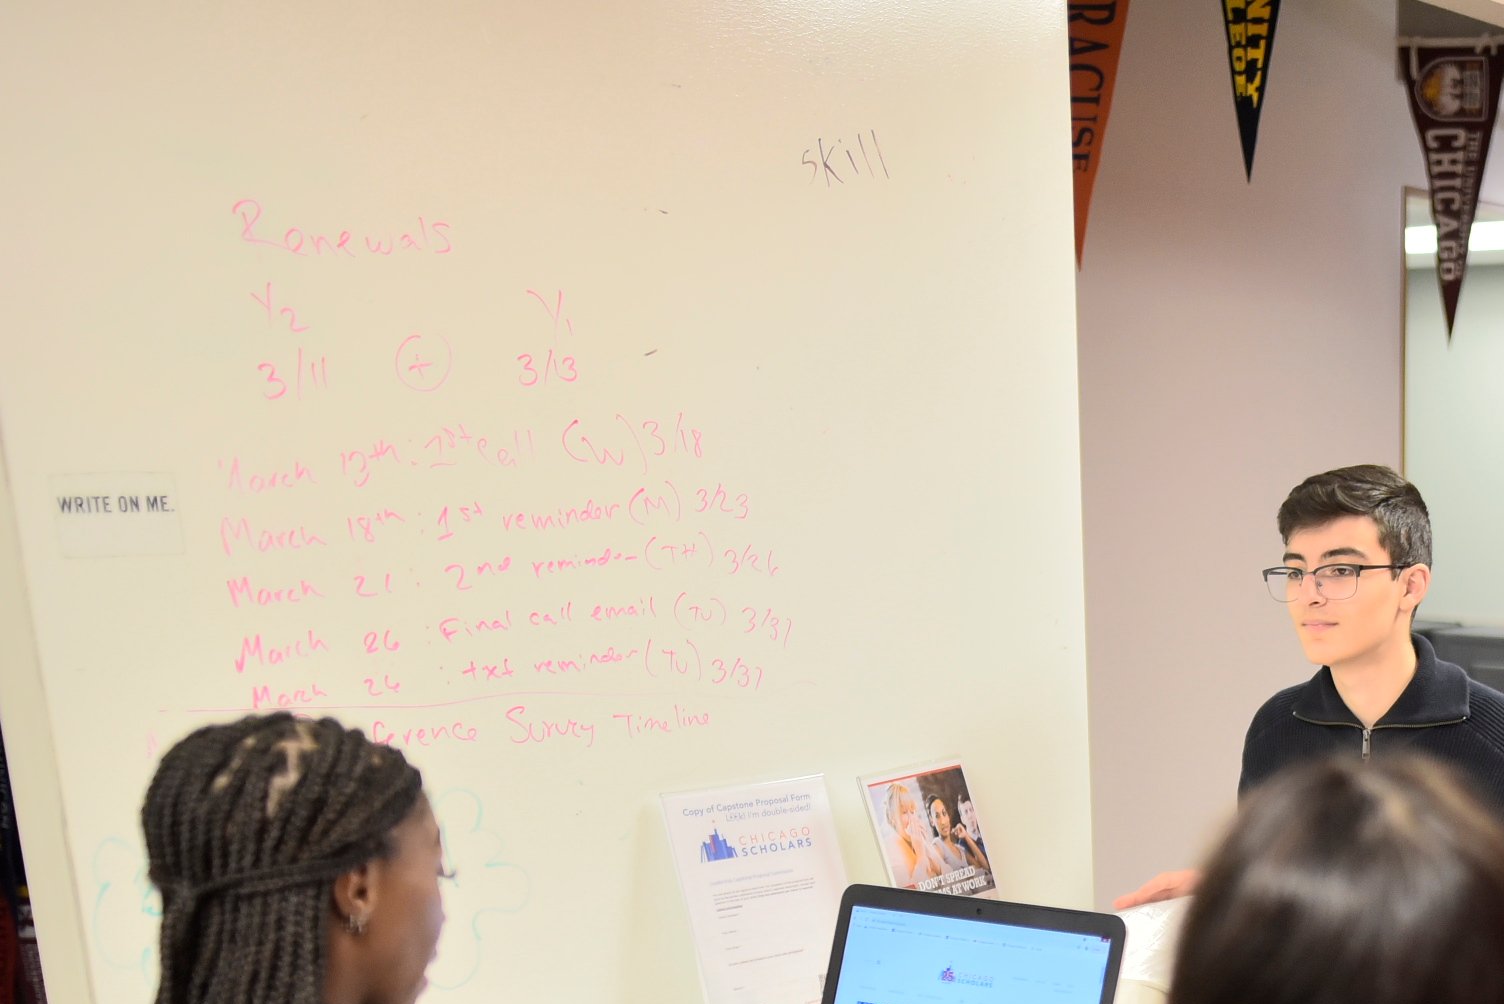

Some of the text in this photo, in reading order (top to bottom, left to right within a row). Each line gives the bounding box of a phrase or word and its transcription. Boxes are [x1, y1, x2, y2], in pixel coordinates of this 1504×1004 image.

[1425, 128, 1466, 281] CHICAGO
[57, 495, 176, 514] WRITE ON ME.
[220, 516, 327, 557] March
[227, 576, 325, 608] March
[235, 630, 329, 673] March
[591, 596, 656, 622] email
[252, 684, 328, 710] March
[683, 793, 811, 817] Copy of Capstone Proposal Form
[762, 803, 811, 817] double-sided!
[738, 826, 810, 846] CHICAGO
[742, 837, 812, 857] SCHOLARS
[918, 875, 945, 891] DON'T
[945, 866, 976, 883] SPREAD
[951, 884, 962, 895] AT
[961, 875, 987, 892] WORK
